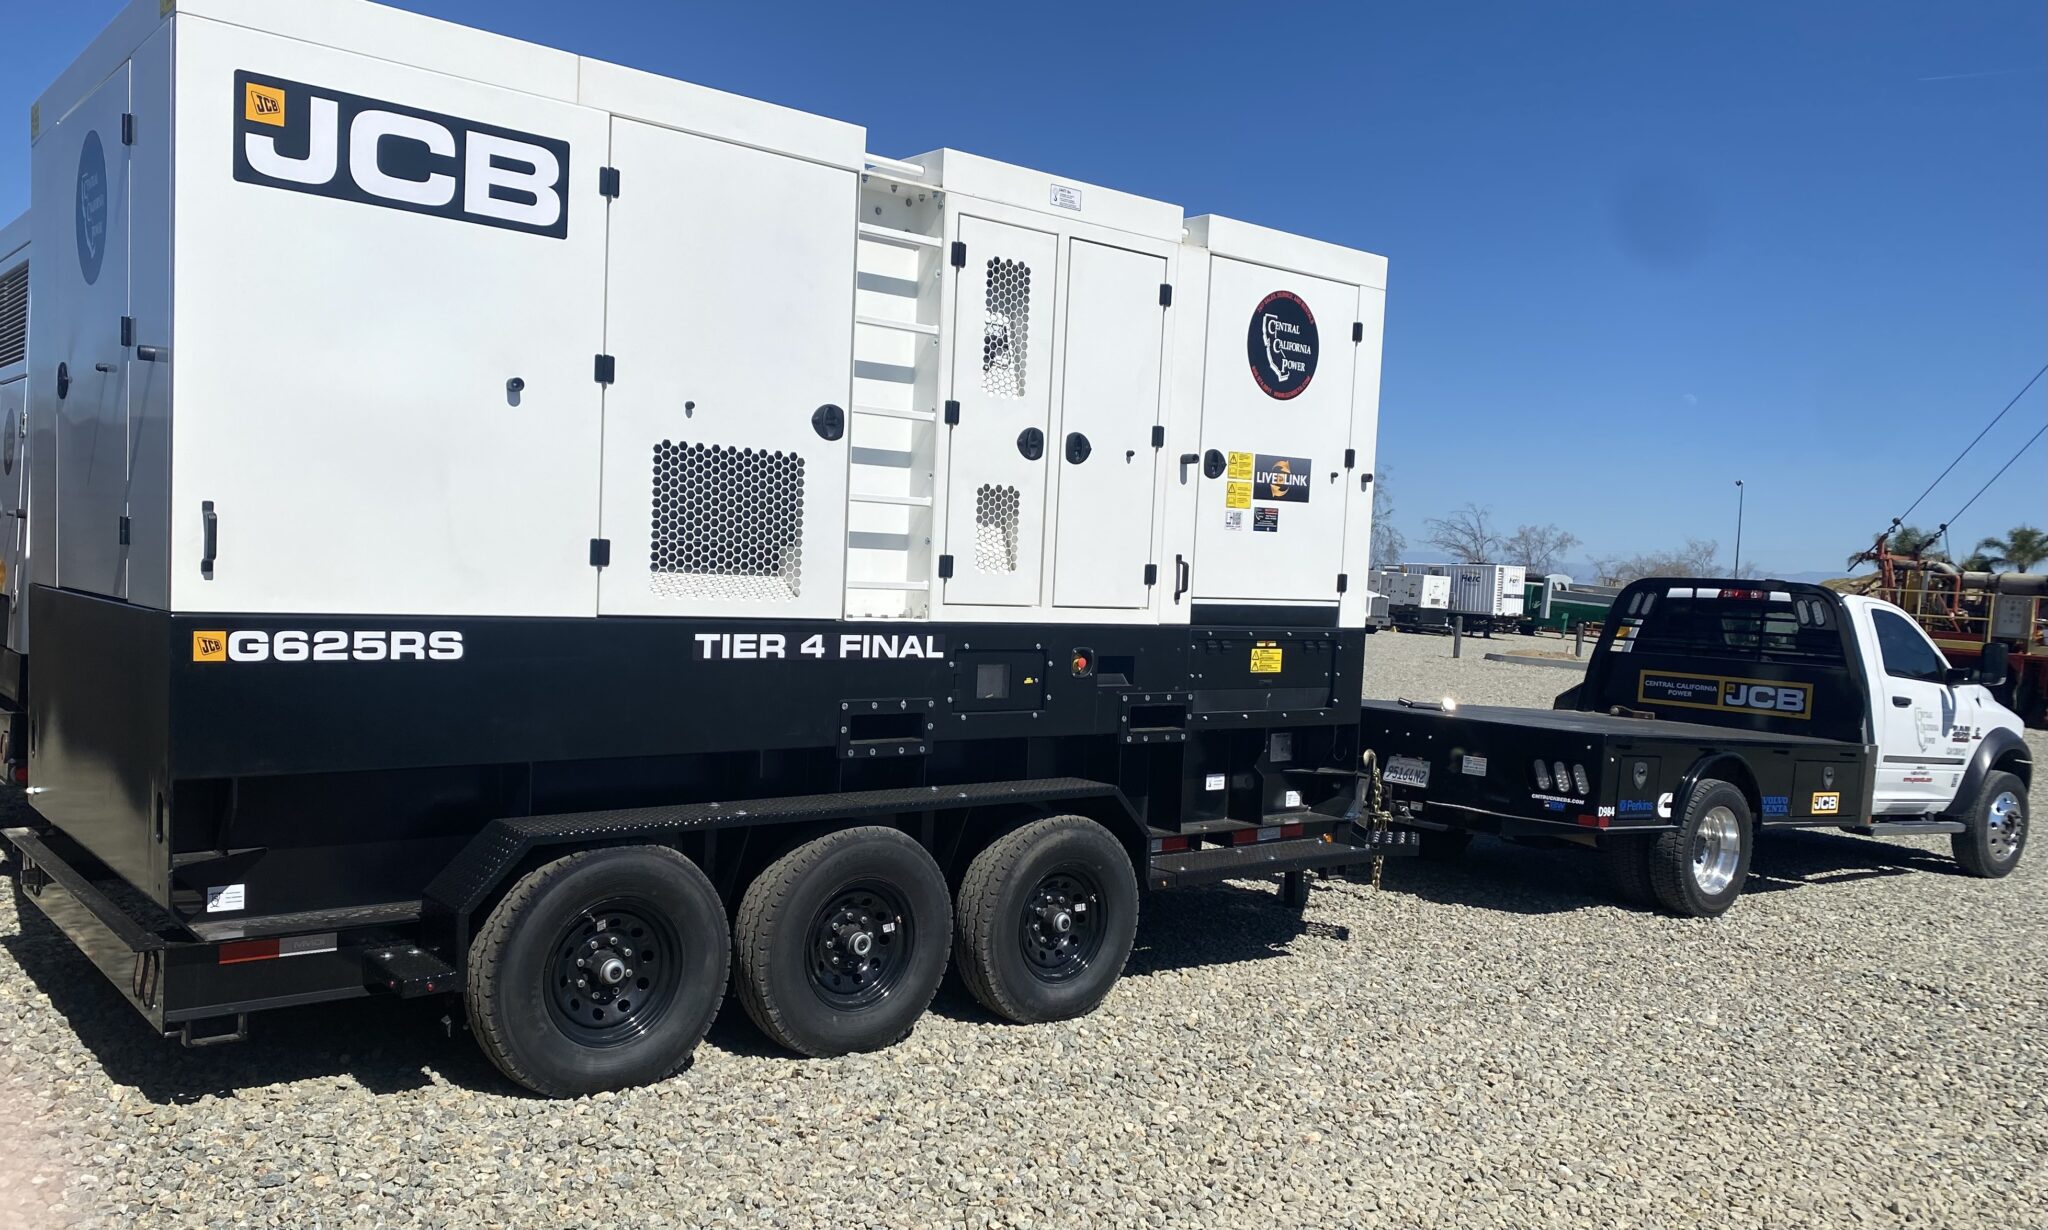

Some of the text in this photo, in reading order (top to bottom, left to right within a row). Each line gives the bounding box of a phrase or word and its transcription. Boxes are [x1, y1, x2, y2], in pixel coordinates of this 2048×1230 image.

[256, 94, 280, 113] JCB
[245, 96, 561, 226] JCB
[1268, 319, 1300, 335] CENTRAL
[1273, 338, 1311, 355] CALIFORNIA
[1281, 358, 1306, 373] POWER
[1461, 573, 1481, 583] Herc
[201, 630, 464, 662] JCB G625RS
[694, 633, 944, 659] TIER 4 FINAL
[1645, 680, 1718, 692] CENTRAL CALIFORNIA
[1668, 688, 1693, 698] POWER
[1725, 684, 1804, 711] JCB
[1627, 799, 1654, 812] Perkins
[1761, 796, 1789, 805] VOLVO
[1814, 796, 1837, 810] JCB
[1598, 806, 1615, 817] D984
[1761, 804, 1789, 813] PENTA
